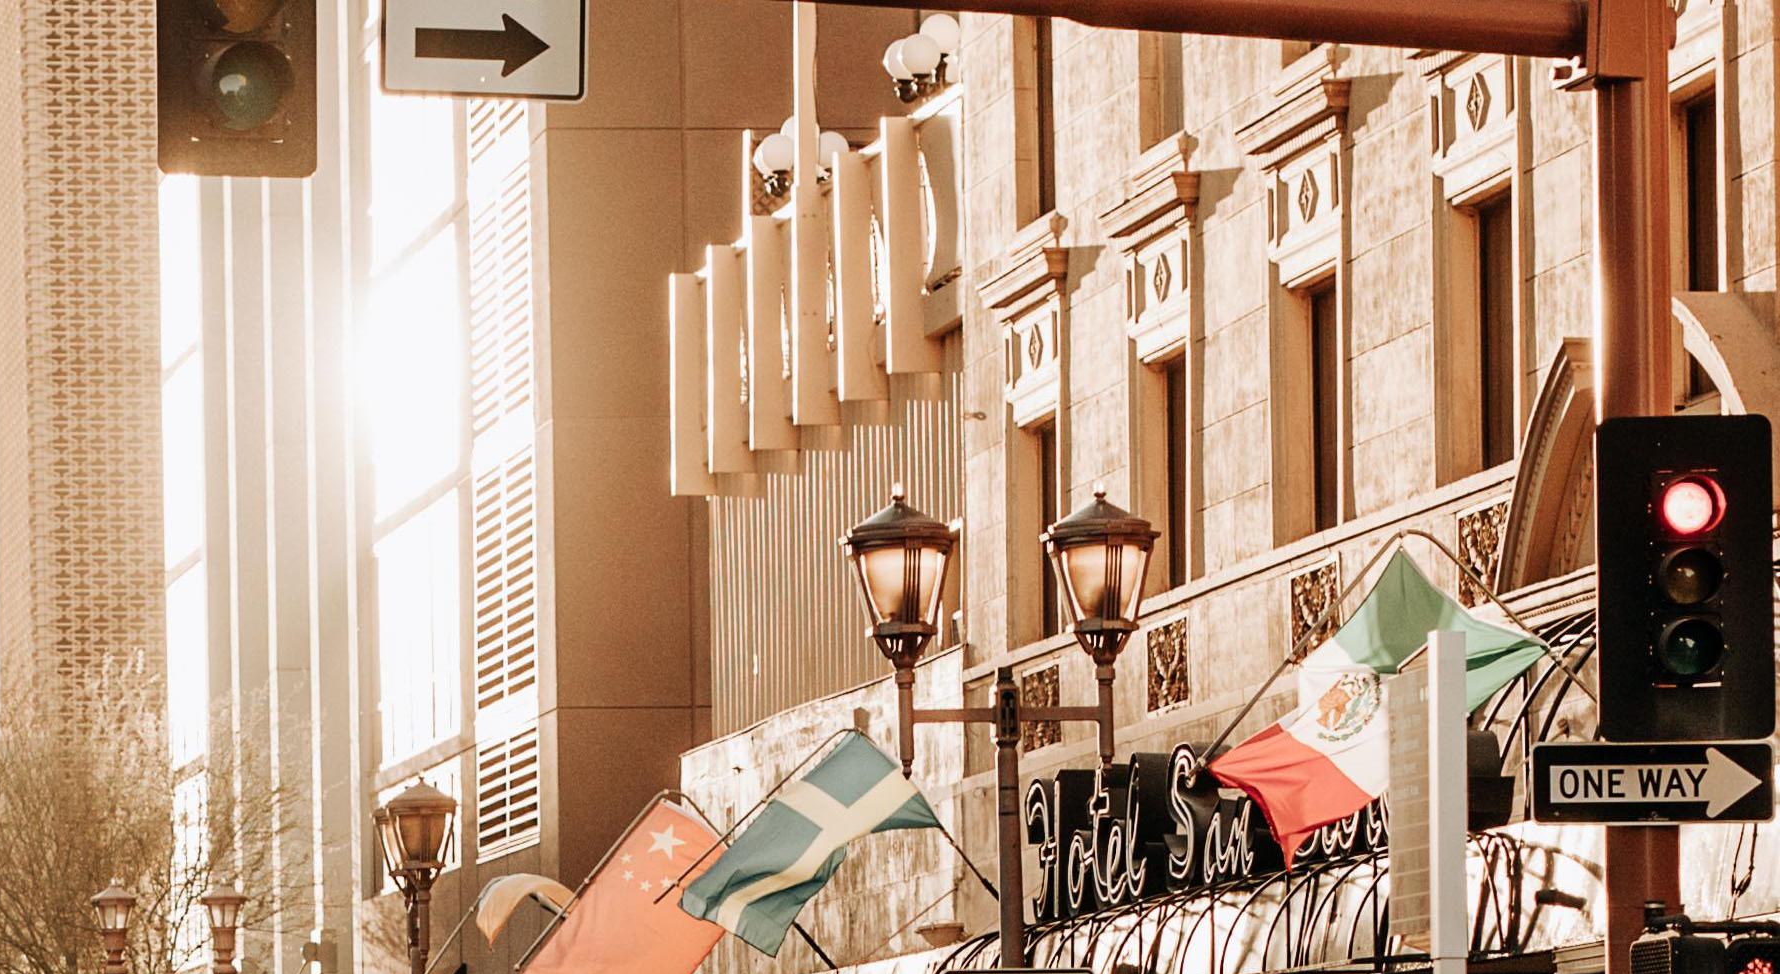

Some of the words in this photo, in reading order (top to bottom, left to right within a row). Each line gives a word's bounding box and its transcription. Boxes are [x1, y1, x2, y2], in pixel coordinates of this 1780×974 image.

[1024, 758, 1148, 919] Hotel
[1169, 744, 1254, 889] San
[1559, 768, 1626, 799] ONE
[1638, 767, 1708, 798] WAY
